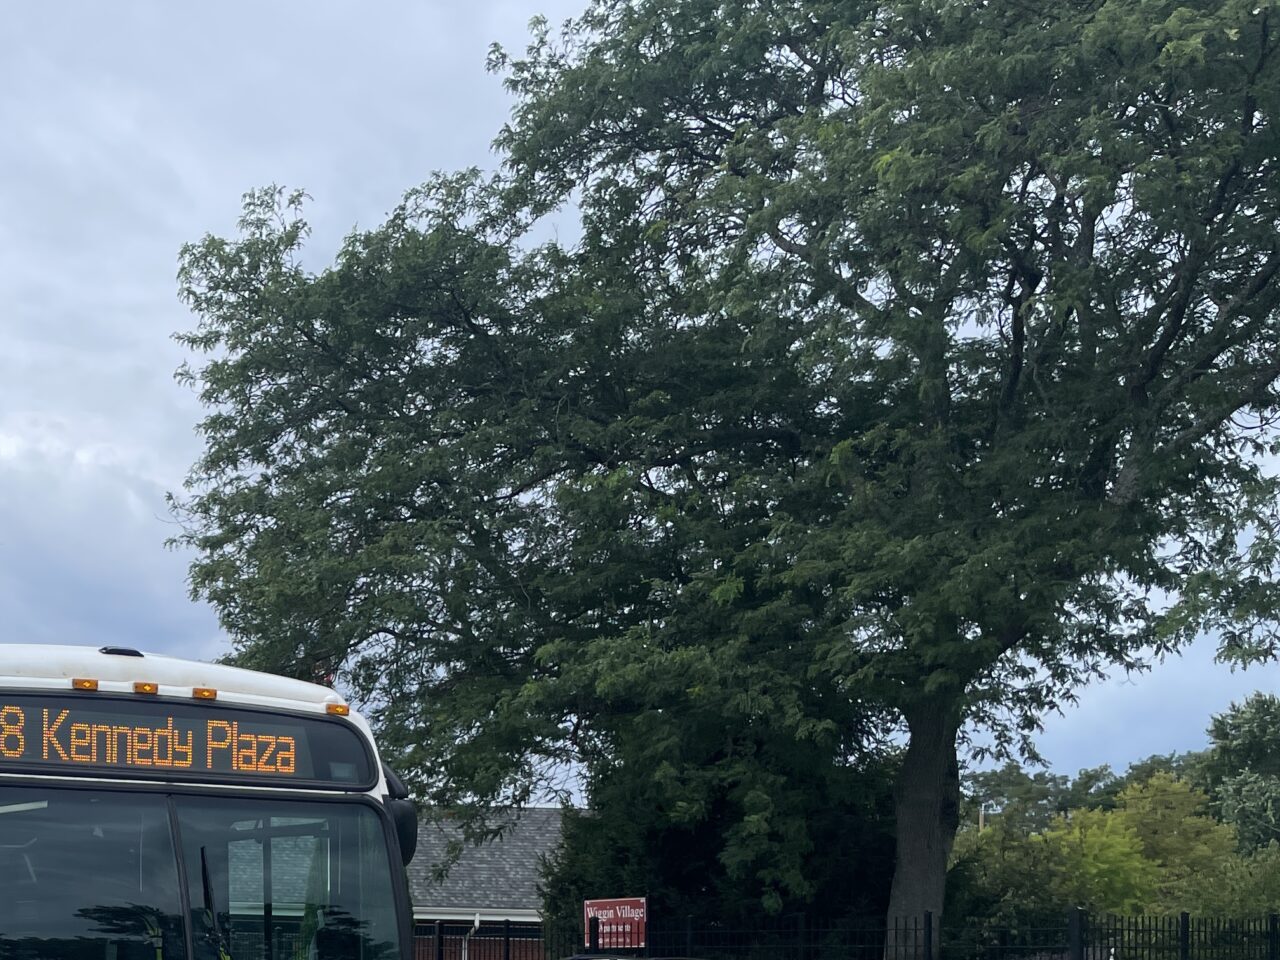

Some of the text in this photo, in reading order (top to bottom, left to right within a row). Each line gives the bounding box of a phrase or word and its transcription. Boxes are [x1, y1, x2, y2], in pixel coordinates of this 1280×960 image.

[42, 708, 193, 768] Kennedy
[206, 719, 295, 774] Plaza
[587, 905, 643, 921] Wiggin Village
